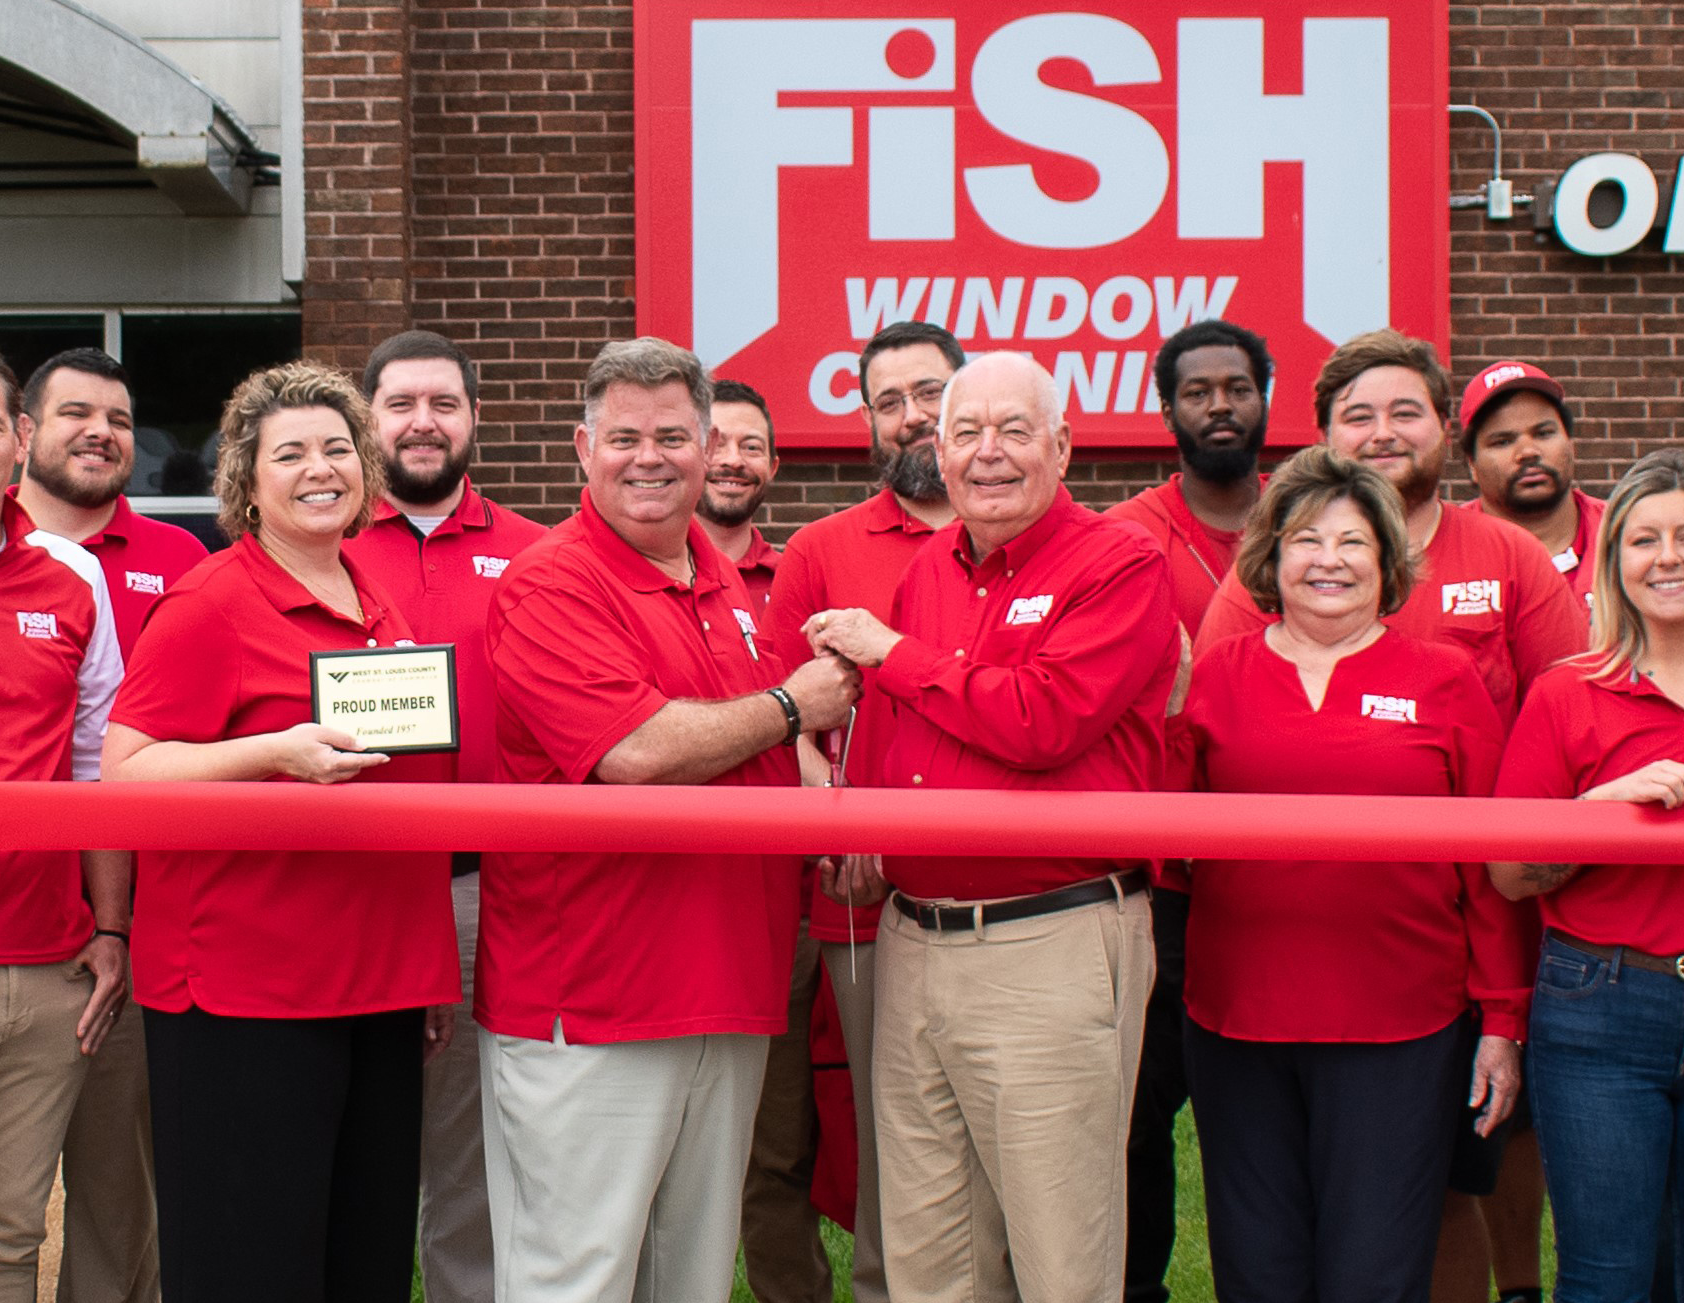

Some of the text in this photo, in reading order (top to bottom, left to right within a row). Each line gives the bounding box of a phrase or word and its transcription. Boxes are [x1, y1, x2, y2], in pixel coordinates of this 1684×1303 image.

[845, 276, 1239, 340] WINDOW
[333, 696, 435, 714] PROUD MEMBER
[356, 726, 393, 736] Founded
